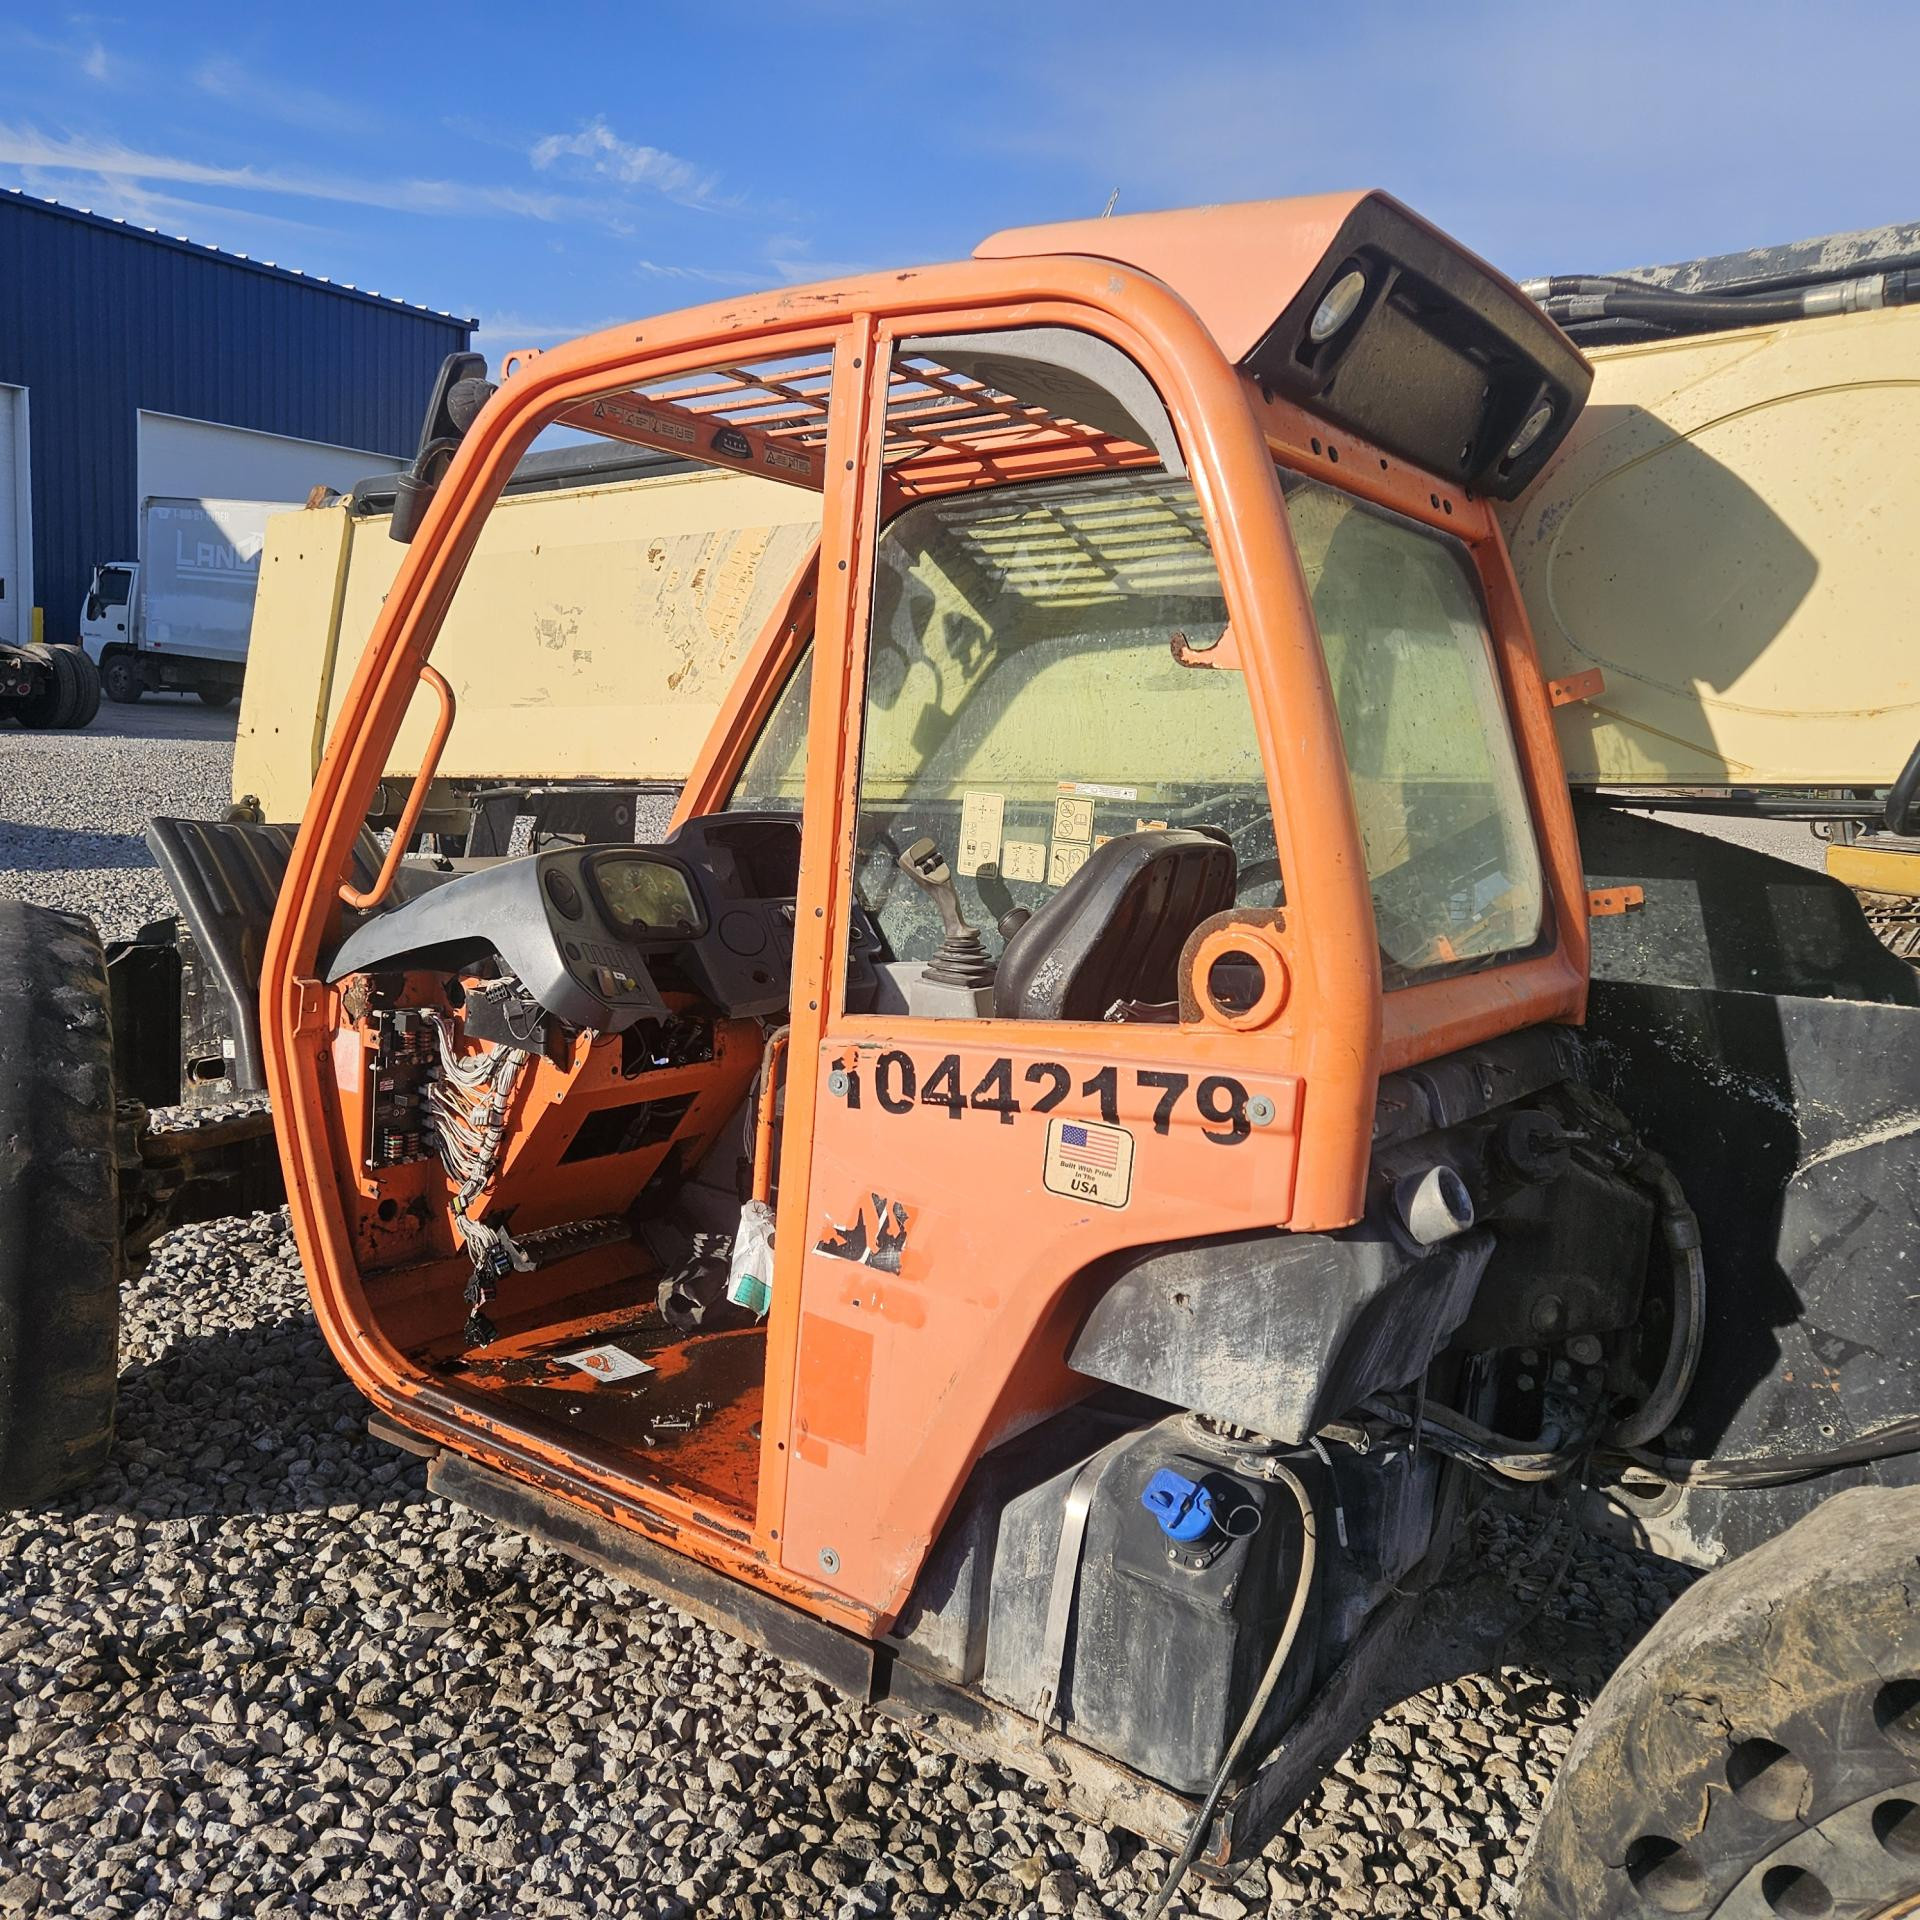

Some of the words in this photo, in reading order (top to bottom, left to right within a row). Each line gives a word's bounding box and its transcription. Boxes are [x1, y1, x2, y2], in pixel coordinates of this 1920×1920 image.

[832, 1050, 1252, 1146] 10442179
[1060, 1160, 1076, 1169] Built
[1078, 1165, 1093, 1173] With
[1094, 1169, 1112, 1178] Pride
[1070, 1178, 1098, 1196] USA
